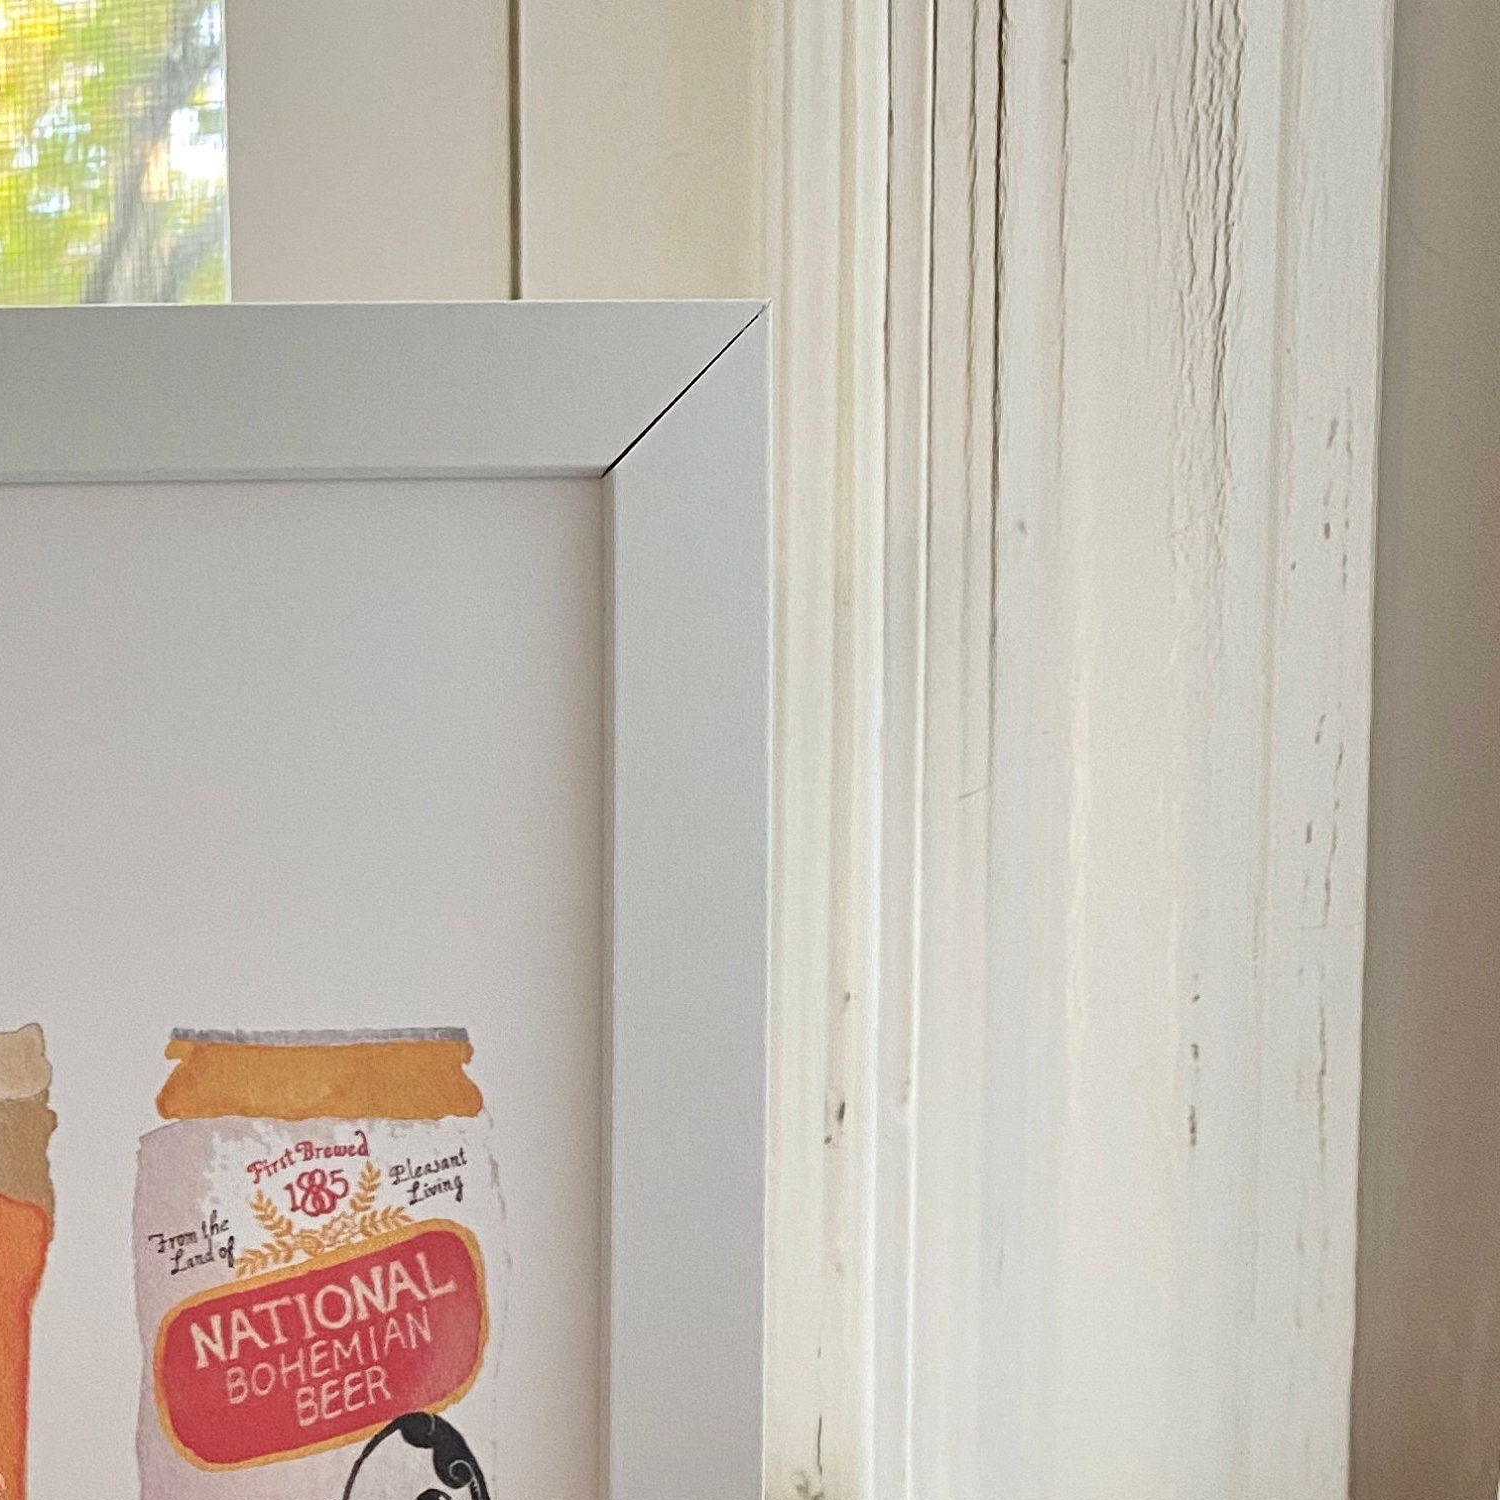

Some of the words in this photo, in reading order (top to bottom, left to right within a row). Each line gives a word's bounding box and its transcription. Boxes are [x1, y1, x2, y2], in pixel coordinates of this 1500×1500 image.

[247, 1148, 295, 1184] First
[295, 1130, 370, 1162] Brewed
[389, 1148, 468, 1185] Pleasant
[284, 1168, 349, 1217] 1885
[408, 1175, 464, 1205] Living
[148, 1230, 197, 1253] From
[201, 1210, 230, 1237] the
[170, 1240, 214, 1276] Land
[218, 1236, 235, 1268] of
[189, 1252, 457, 1369] NATIONAL
[224, 1306, 433, 1405] BOHEMIAN
[295, 1366, 392, 1427] BEER
